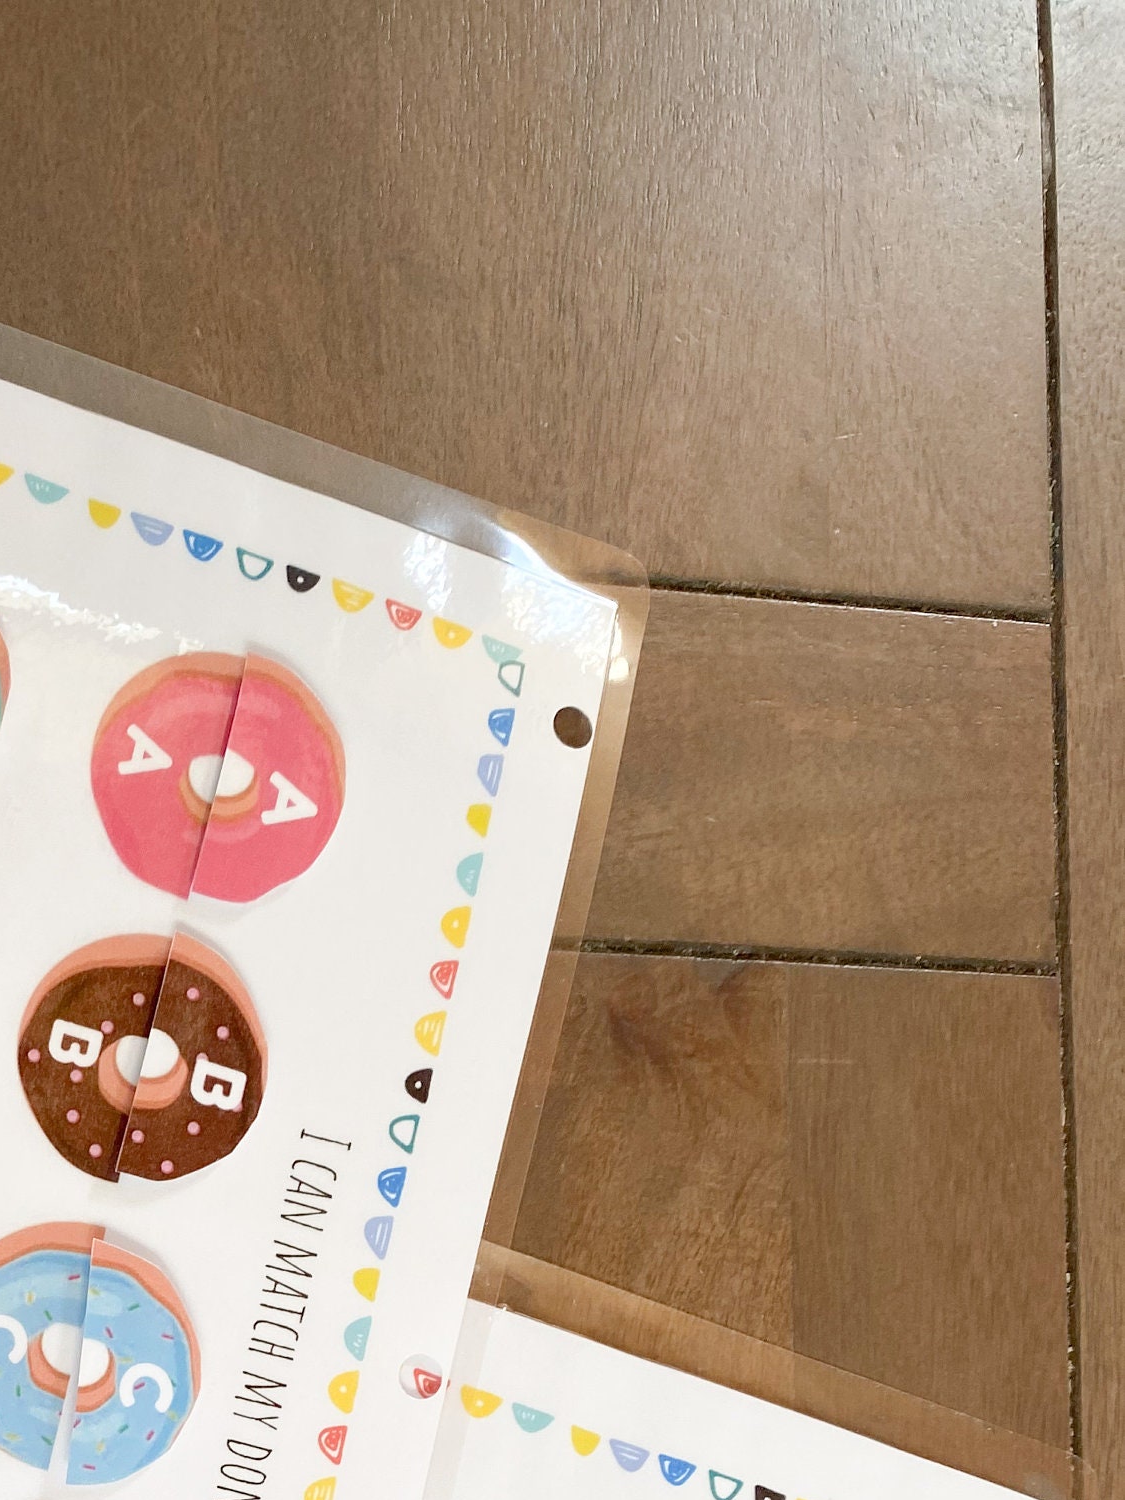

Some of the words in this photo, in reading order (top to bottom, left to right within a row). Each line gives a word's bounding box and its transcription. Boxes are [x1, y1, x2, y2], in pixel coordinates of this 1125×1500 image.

[118, 724, 173, 775] A
[260, 771, 318, 825] A
[48, 1019, 104, 1068] B
[190, 1053, 247, 1111] B
[300, 1128, 352, 1151] I
[280, 1159, 337, 1232] CAN
[248, 1239, 318, 1361] MATCH
[118, 1362, 174, 1413] C
[233, 1370, 287, 1430] MY
